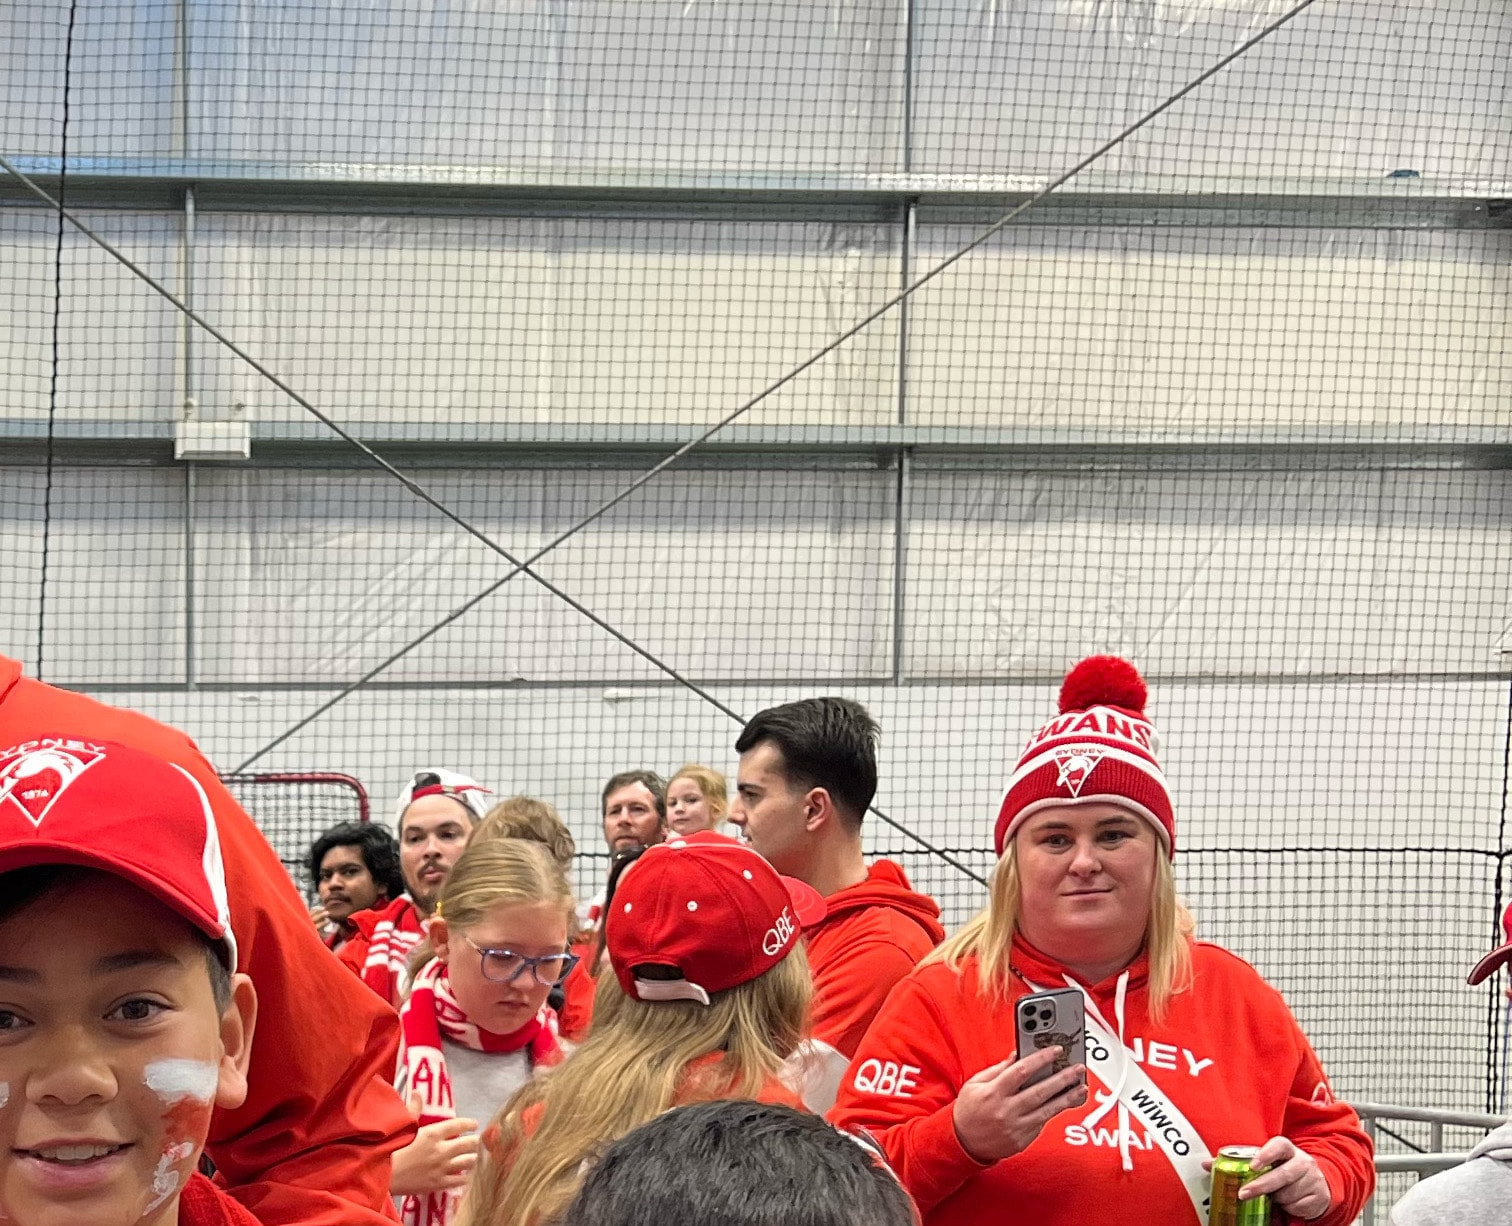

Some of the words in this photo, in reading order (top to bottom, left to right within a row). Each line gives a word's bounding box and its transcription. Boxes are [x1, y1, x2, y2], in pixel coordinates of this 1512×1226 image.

[1021, 712, 1151, 758] WANS
[762, 905, 795, 956] QBE
[854, 1058, 921, 1098] QBE
